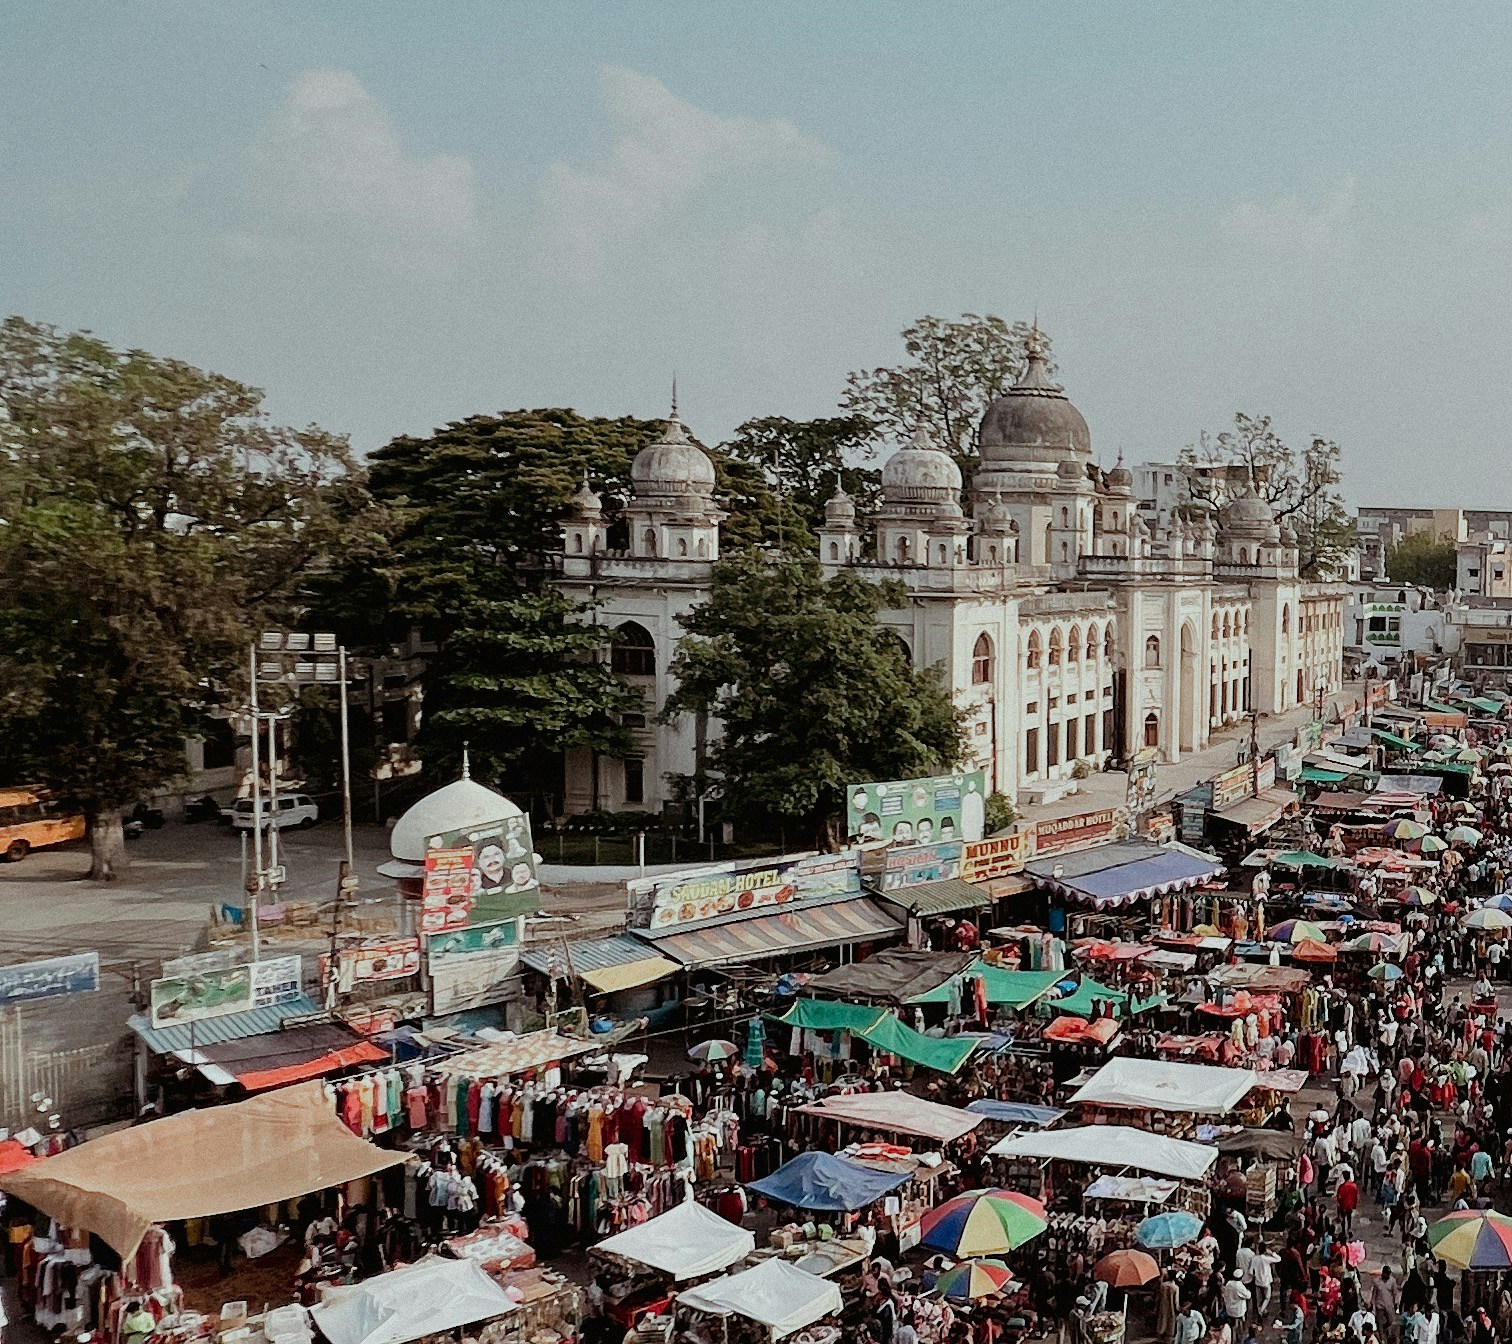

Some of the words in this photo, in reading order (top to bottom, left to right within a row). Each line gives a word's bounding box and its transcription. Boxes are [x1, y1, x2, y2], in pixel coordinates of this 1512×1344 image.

[1086, 812, 1112, 825] HOTEL
[966, 837, 1020, 859] MUNNU
[735, 869, 780, 892] HOTEL
